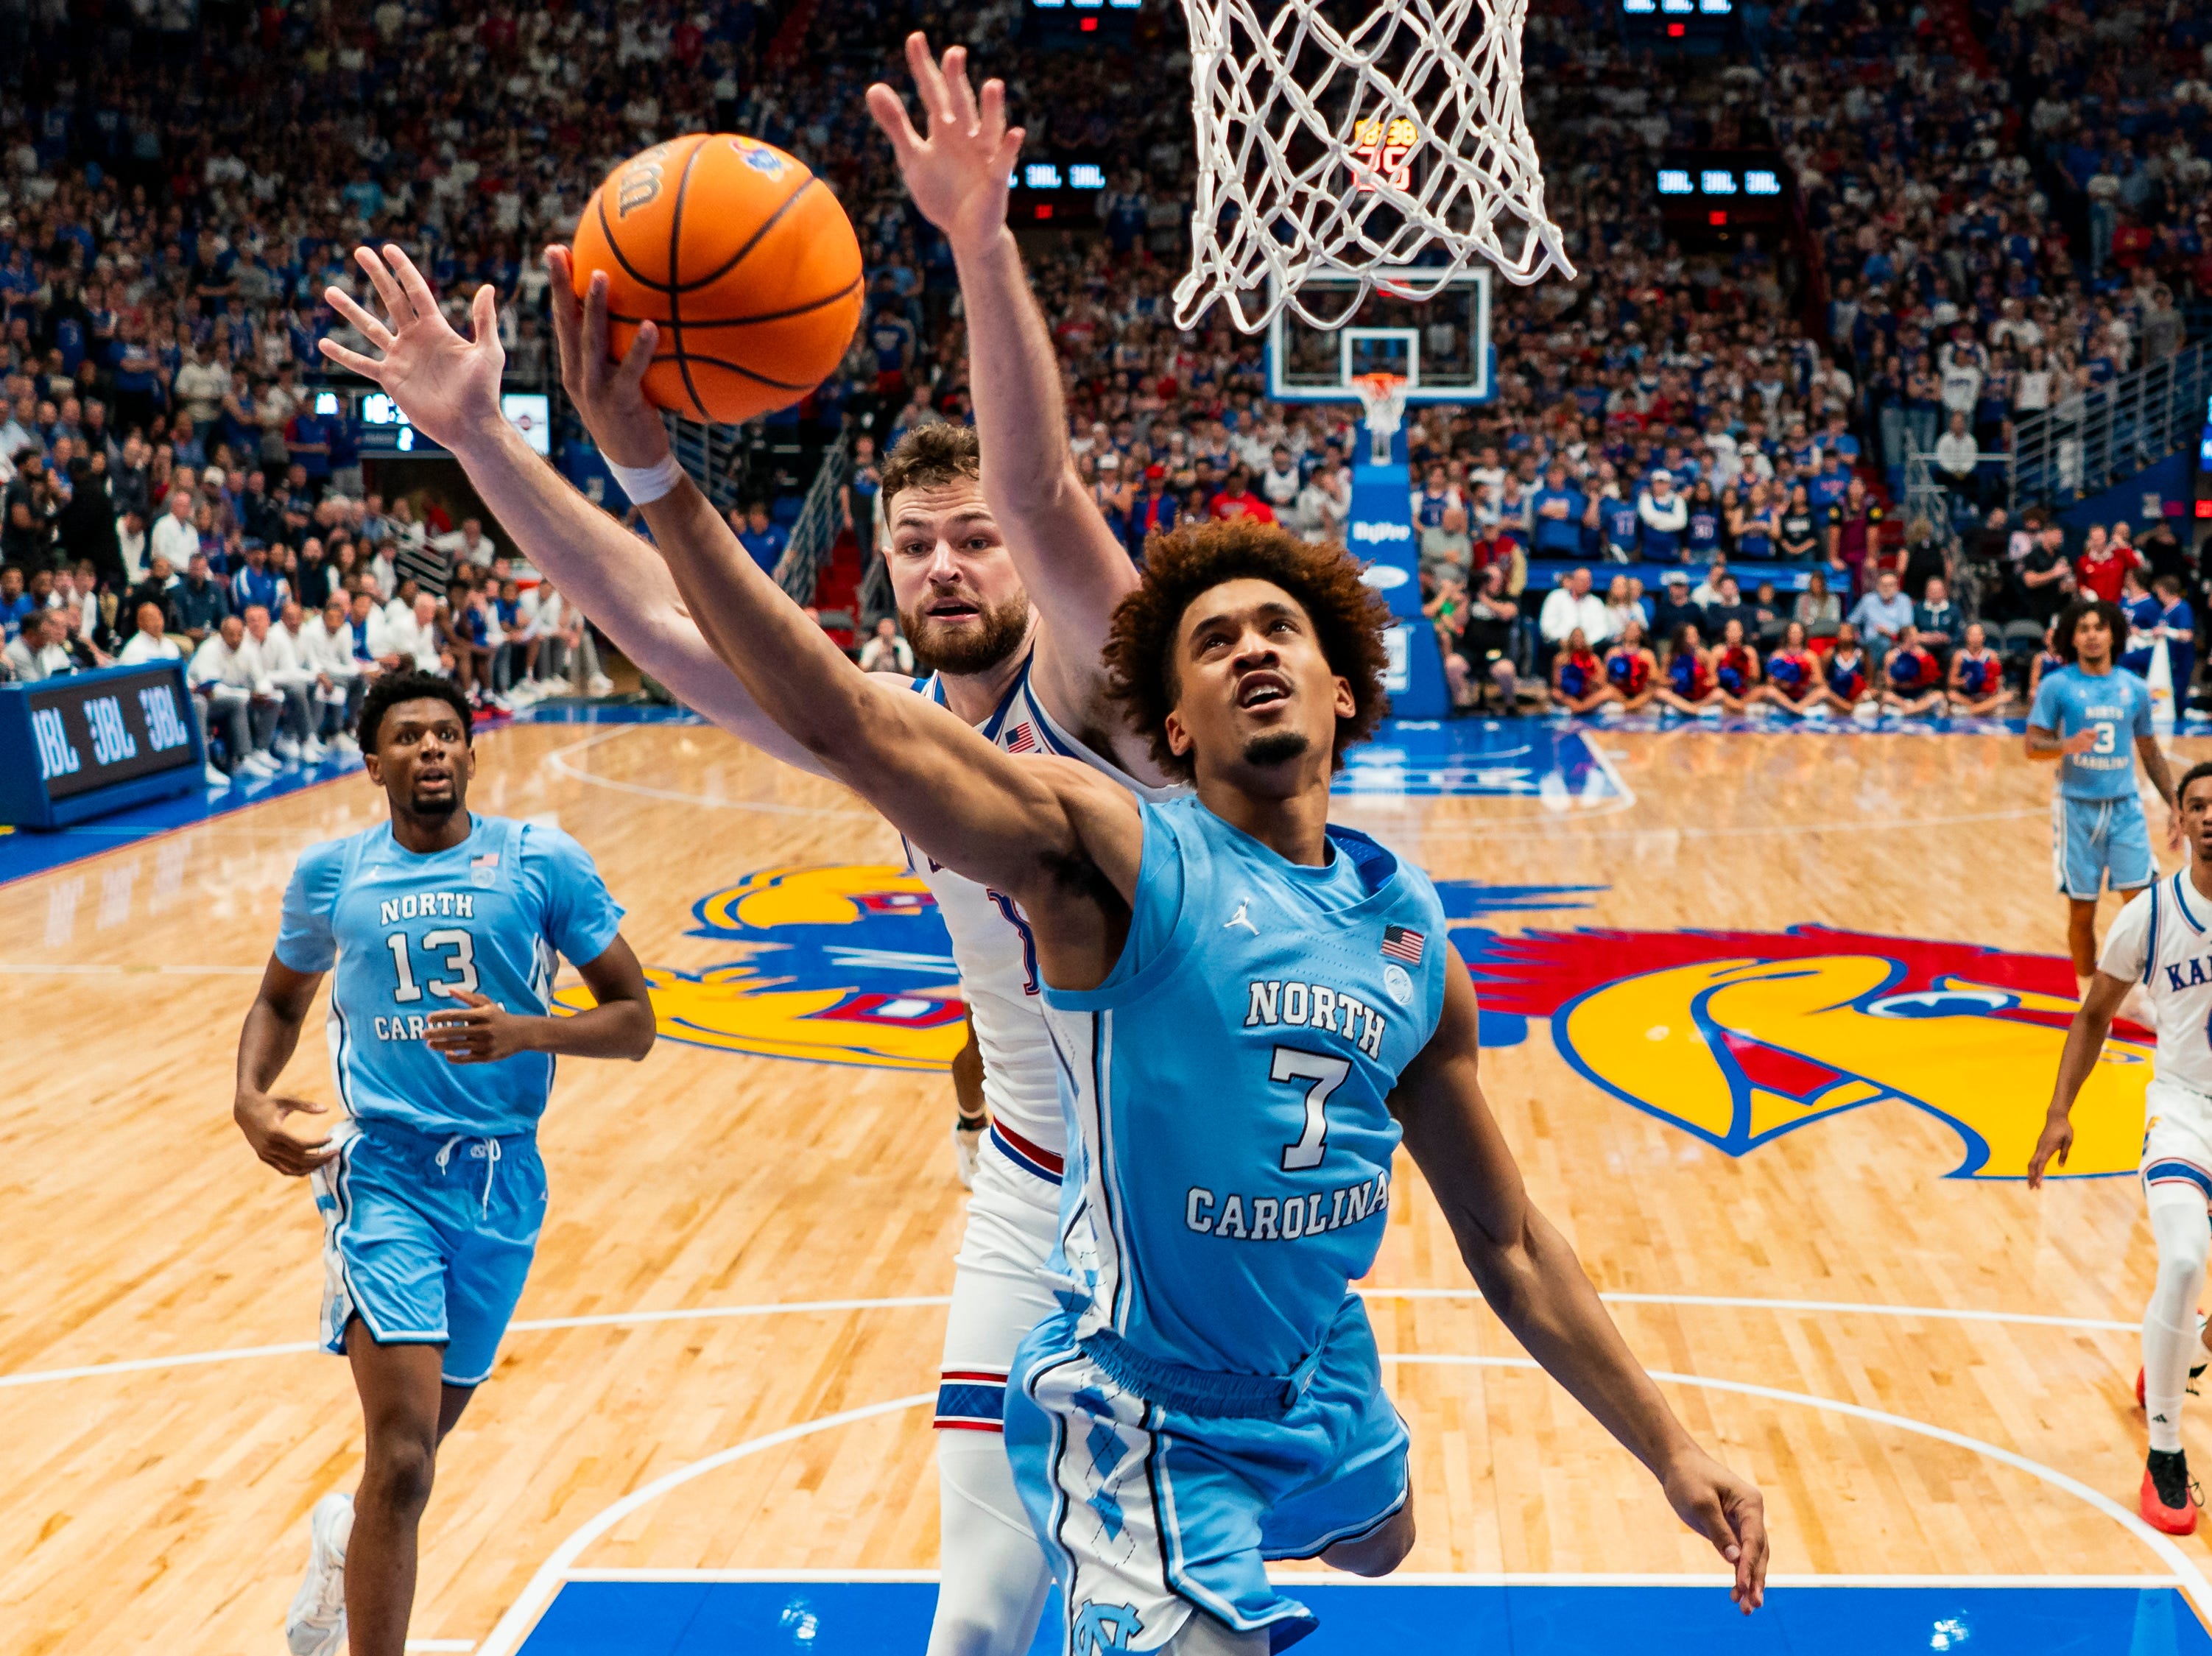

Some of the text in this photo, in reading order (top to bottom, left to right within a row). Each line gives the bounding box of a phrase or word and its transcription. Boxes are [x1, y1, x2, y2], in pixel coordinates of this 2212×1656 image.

[83, 695, 138, 766] JBL
[138, 684, 189, 752] JBL
[2092, 721, 2116, 754] 3
[379, 891, 475, 926] NORTH
[386, 928, 479, 1003] 13
[2164, 955, 2212, 992] KA
[1244, 980, 1387, 1062] NORTH
[1269, 1043, 1353, 1172] 7
[1186, 1171, 1389, 1242] CAROLINA
